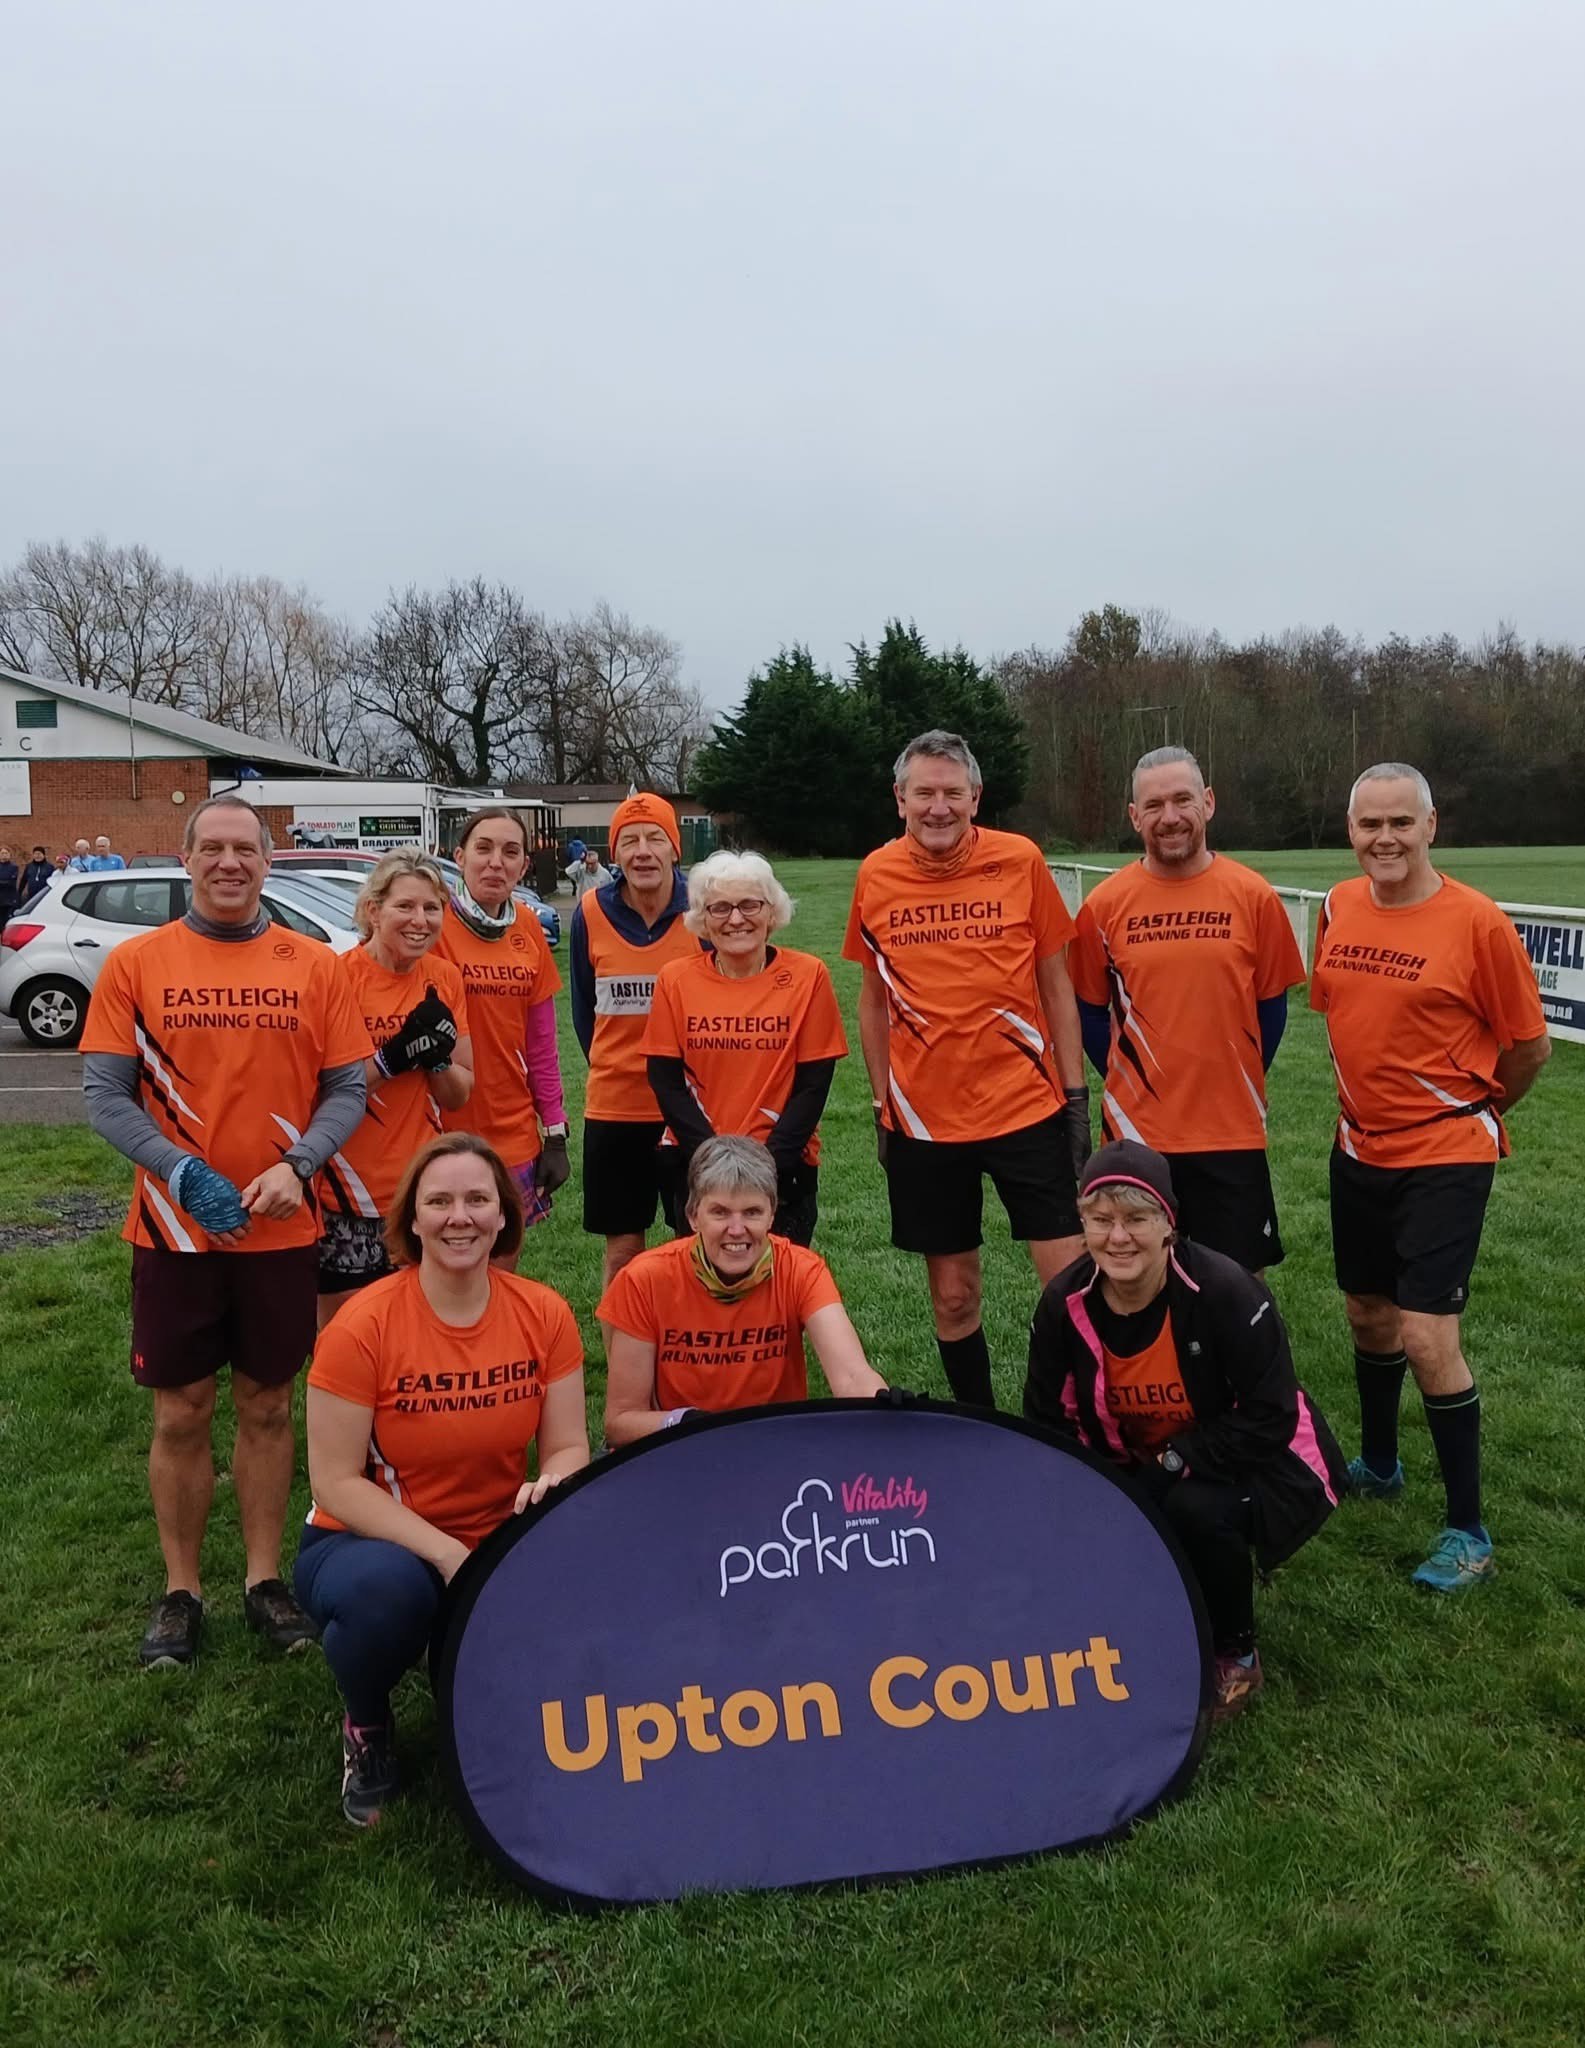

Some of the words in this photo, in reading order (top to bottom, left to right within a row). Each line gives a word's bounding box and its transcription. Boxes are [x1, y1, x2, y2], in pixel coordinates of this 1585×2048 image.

[307, 821, 336, 829] TOMATO
[337, 821, 356, 829] PLANT
[889, 901, 1002, 929] EASTLEIGH
[1126, 910, 1233, 932] EASTLEIGH
[890, 927, 959, 948] RUNNING
[965, 924, 1004, 939] CLUB
[1126, 928, 1190, 945] RUNNING
[1195, 927, 1231, 940] CLUB
[1329, 943, 1427, 971] EASTLEIGH
[462, 963, 537, 982] ASTLEIGH
[1324, 958, 1382, 975] RUNNING
[1383, 966, 1421, 982] CLUB
[163, 988, 299, 1010] EASTLEIGH
[610, 982, 655, 998] EASTLEI
[163, 1013, 250, 1031] RUNNING
[256, 1013, 299, 1032] CLUB
[687, 1016, 791, 1033] EASTLEIGH
[687, 1037, 751, 1050] RUNNING
[661, 1350, 748, 1365] RUNNING
[394, 1393, 497, 1413] RUNNING
[1107, 1382, 1185, 1406] STLEIG
[840, 1473, 928, 1519] Vitality
[845, 1516, 880, 1529] partners
[719, 1510, 937, 1597] parkrun
[541, 1680, 843, 1783] Upton
[869, 1635, 1131, 1729] Court
